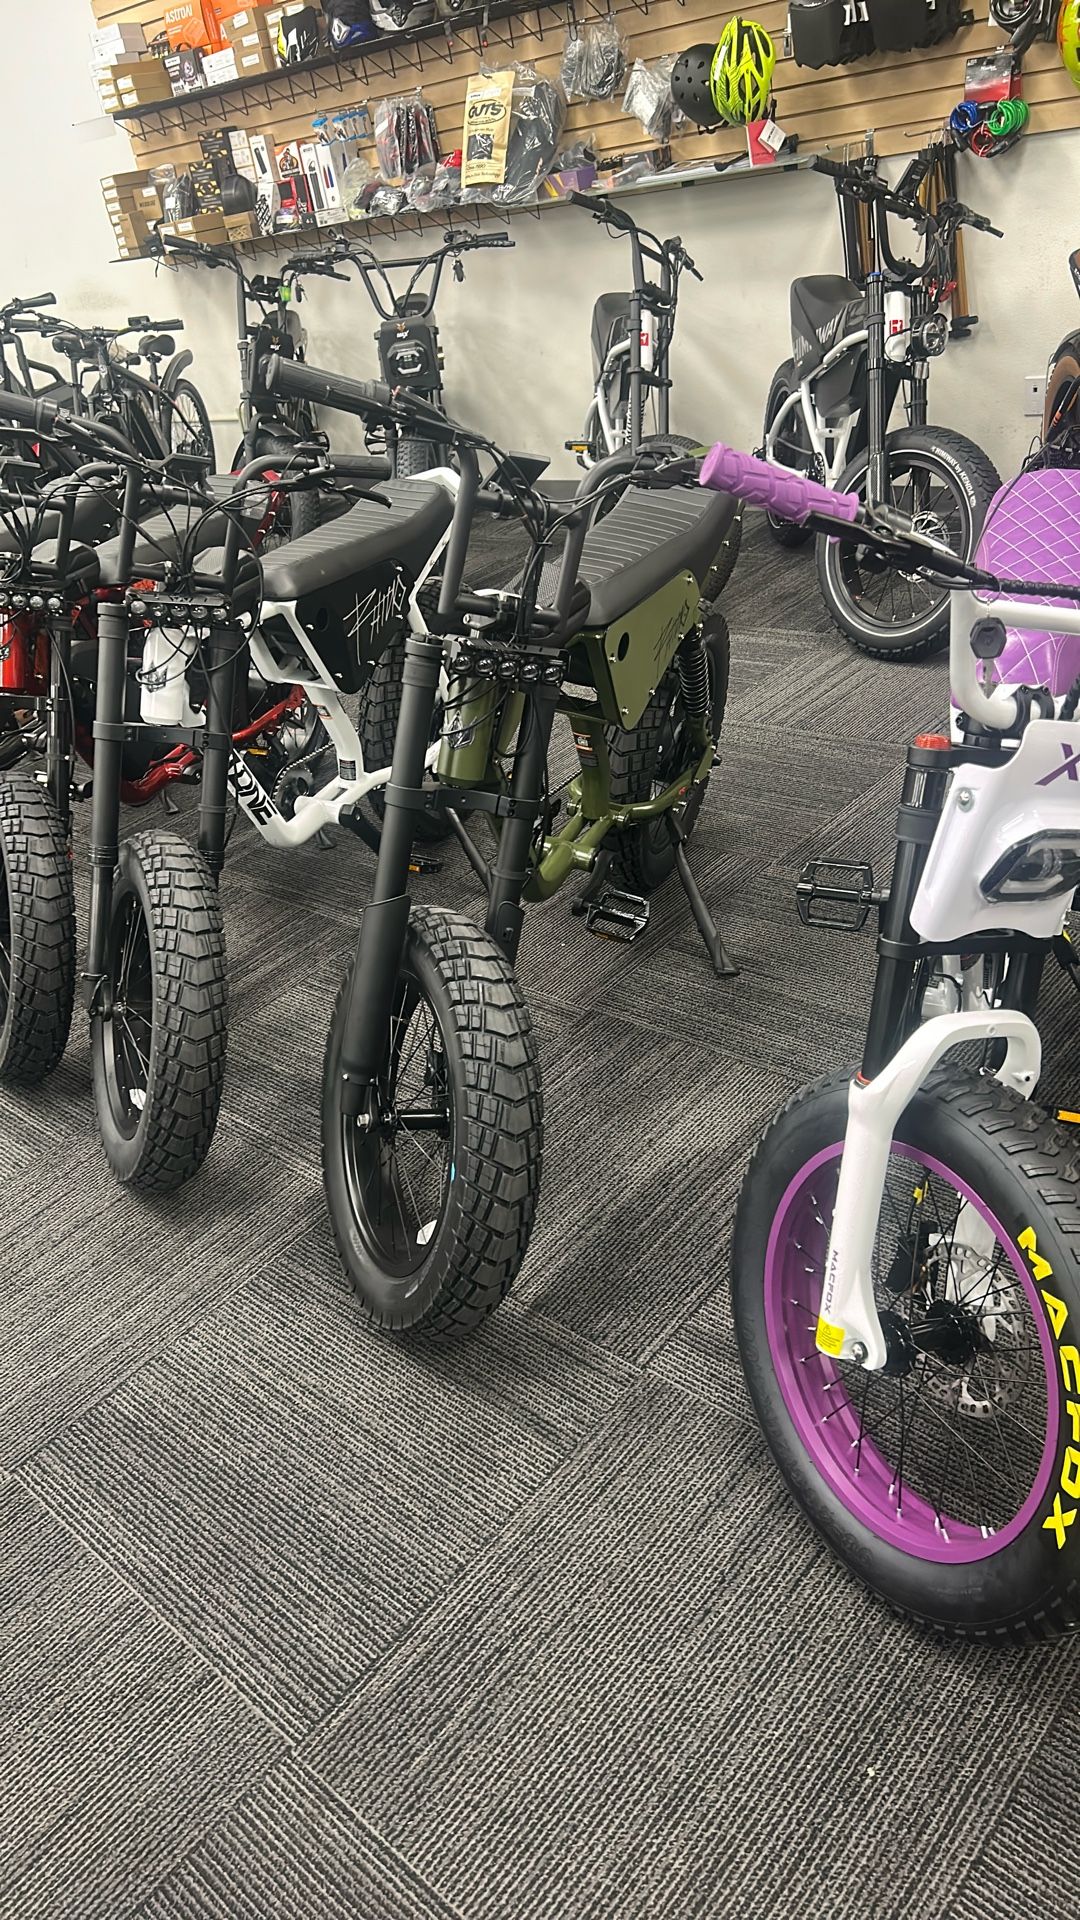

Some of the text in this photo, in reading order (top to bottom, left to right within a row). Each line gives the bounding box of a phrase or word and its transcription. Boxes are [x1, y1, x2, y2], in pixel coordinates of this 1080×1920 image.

[468, 101, 504, 119] GUTS
[959, 471, 975, 496] KENDA
[824, 1249, 839, 1315] MACFOX
